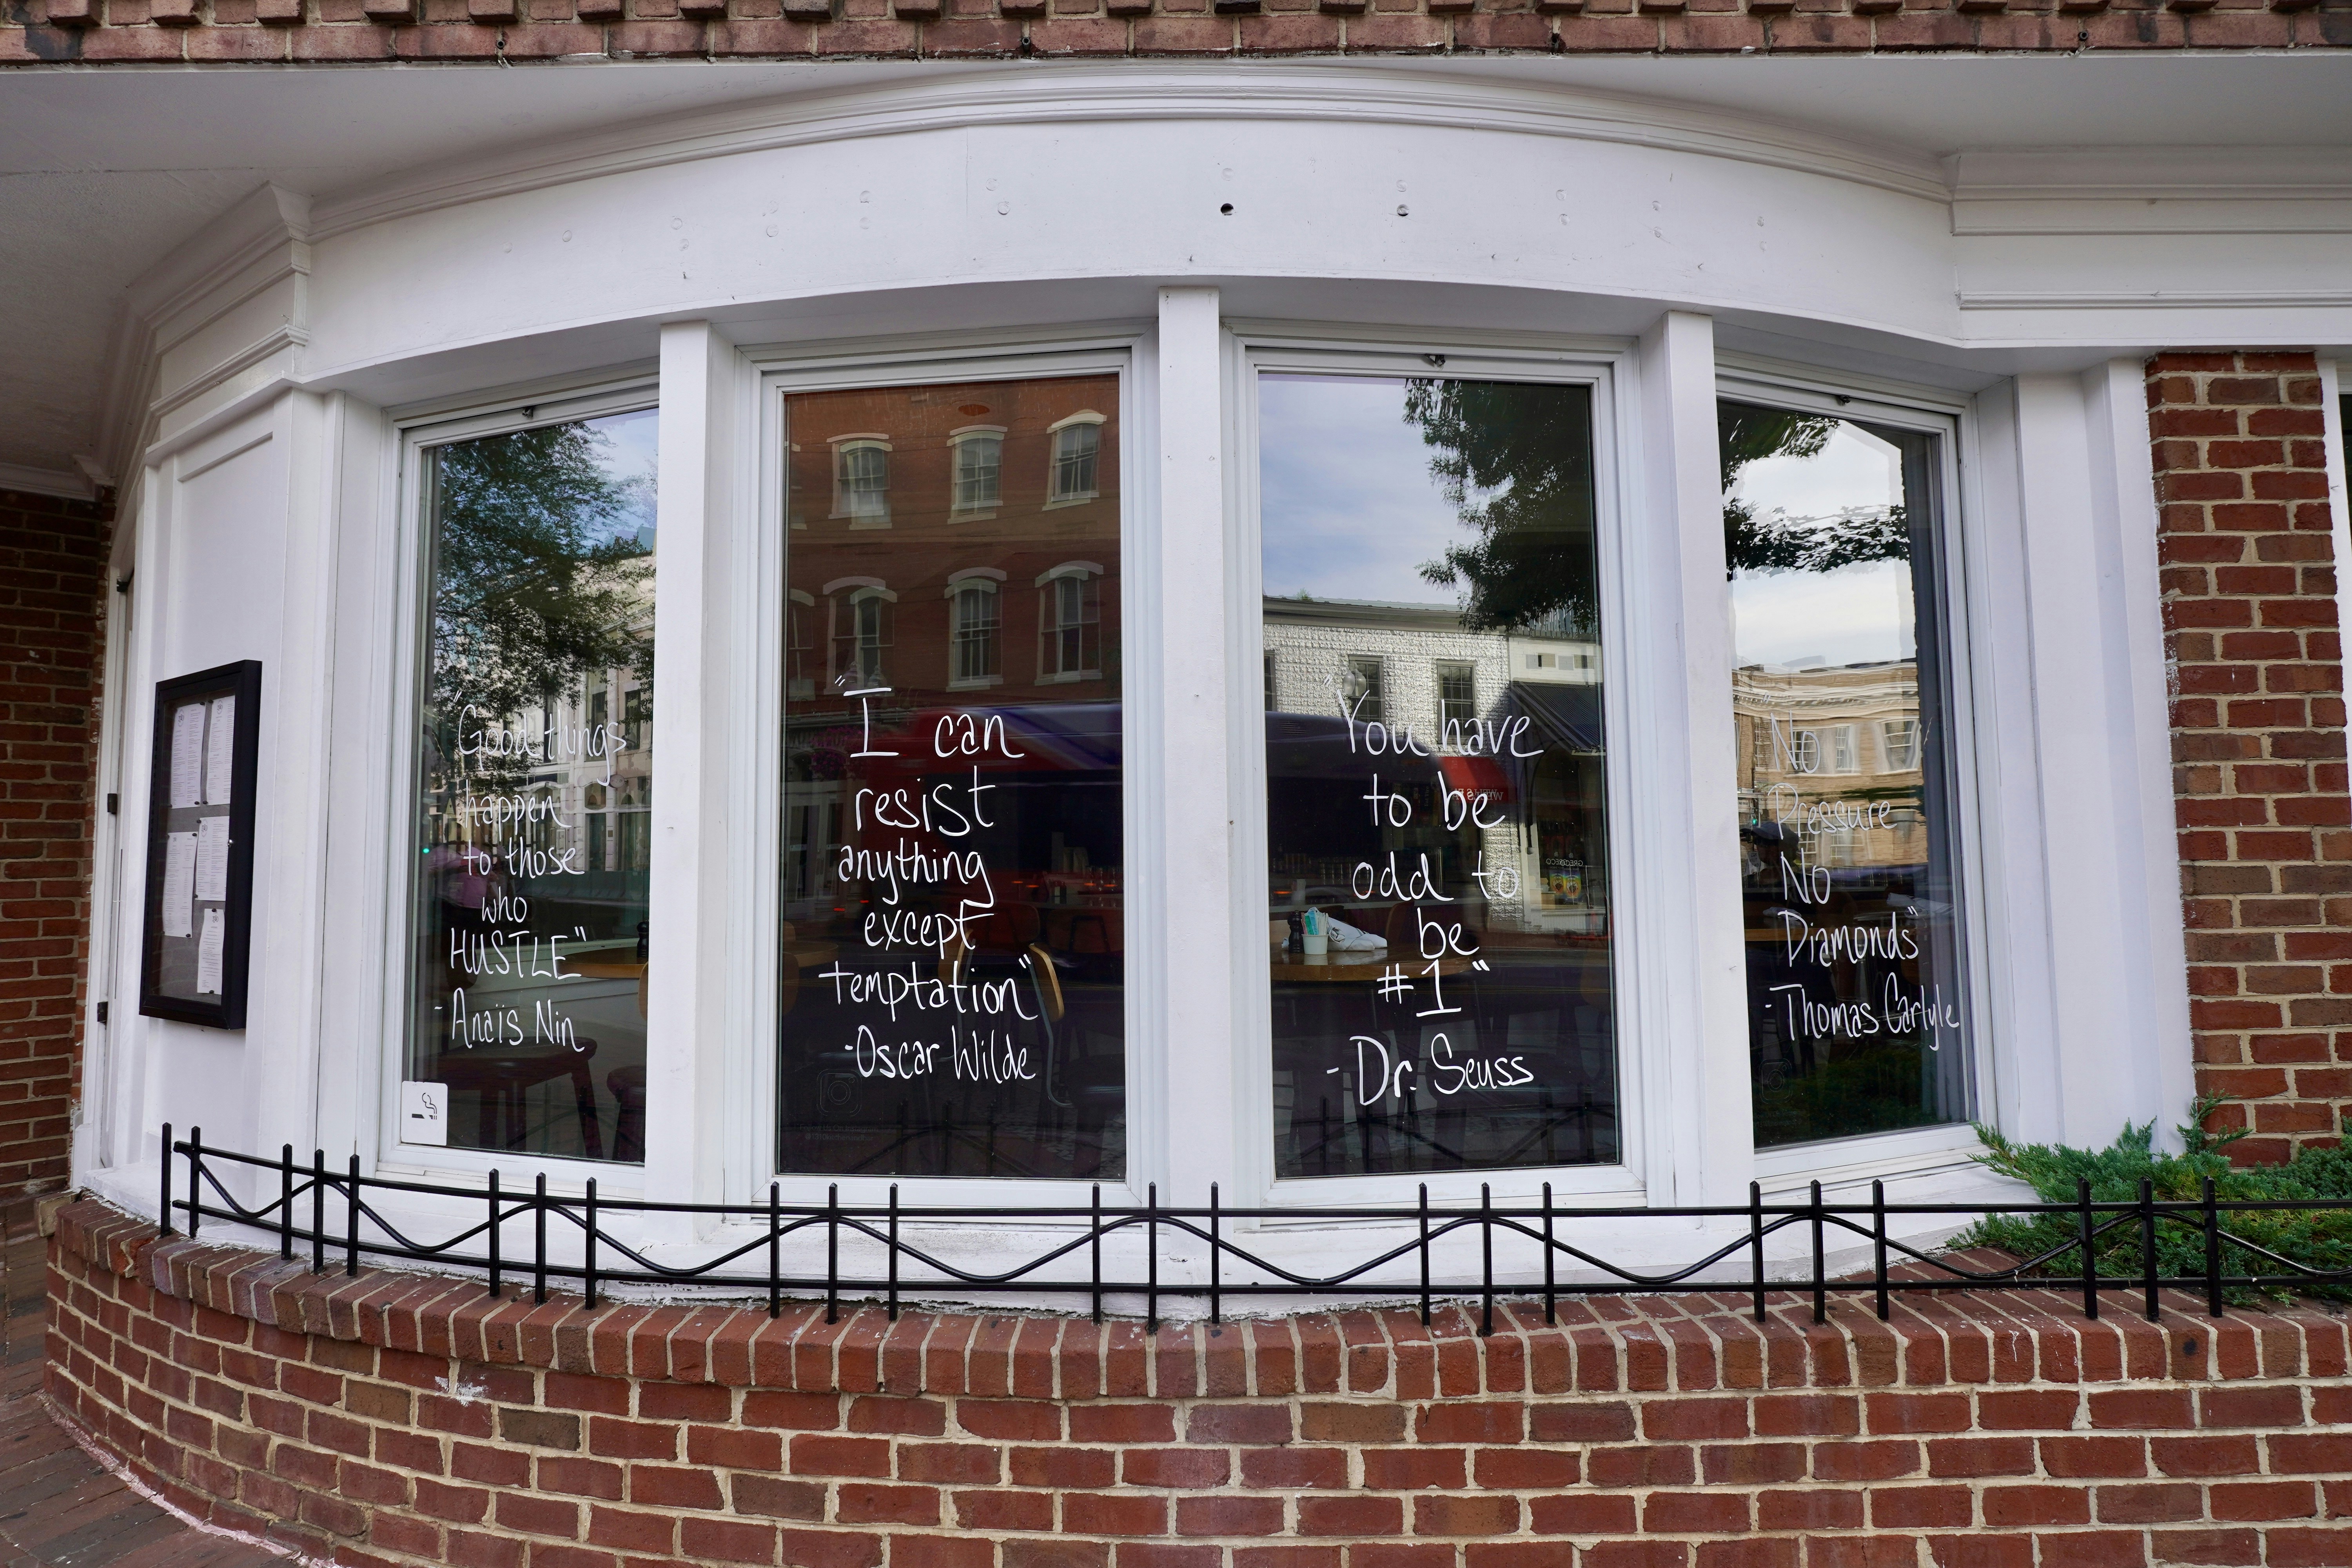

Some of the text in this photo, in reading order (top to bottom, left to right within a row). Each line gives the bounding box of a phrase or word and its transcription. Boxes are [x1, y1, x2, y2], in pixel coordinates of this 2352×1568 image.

[544, 709, 627, 786] things
[935, 713, 1025, 758] can
[1441, 699, 1544, 757] have
[465, 780, 572, 841] happen
[856, 765, 997, 836] resist
[1363, 771, 1506, 831] to be
[1767, 782, 1897, 840] Pressure
[463, 837, 584, 878] to those
[838, 837, 994, 908] anything
[1353, 850, 1518, 901] odd to
[1780, 847, 1831, 904] No
[482, 886, 526, 923] who
[865, 901, 995, 959] except
[1417, 907, 1479, 959] be
[536, 999, 584, 1052] Nin
[1885, 972, 1959, 1051] Carlyle
[951, 1025, 1036, 1083] Wilde
[1431, 1033, 1534, 1094] Seuss
[845, 1125, 878, 1133] Instagram
